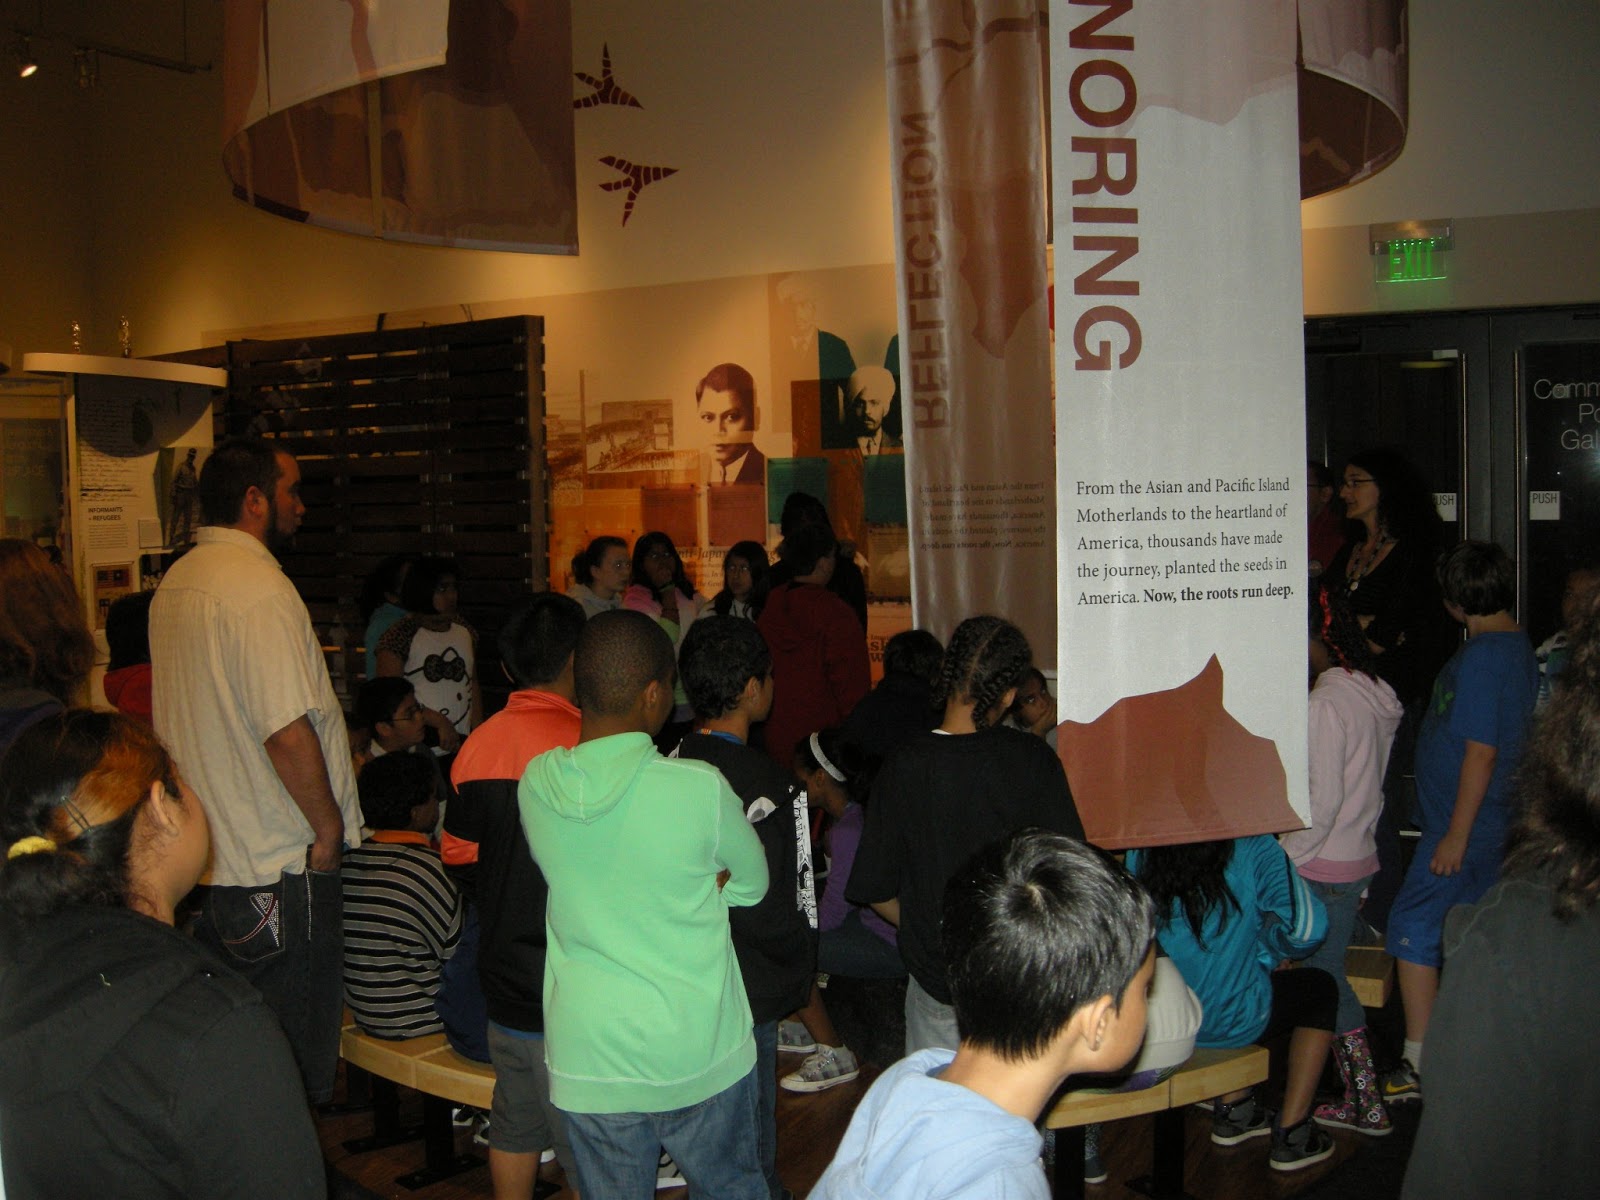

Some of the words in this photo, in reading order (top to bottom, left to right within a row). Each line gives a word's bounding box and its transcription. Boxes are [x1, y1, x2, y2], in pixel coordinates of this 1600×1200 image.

[1068, 0, 1142, 372] NORING
[1388, 241, 1441, 279] EXIT
[1076, 481, 1114, 496] From
[1119, 480, 1142, 495] the
[1145, 480, 1183, 494] Asian
[1187, 478, 1212, 493] and
[1215, 477, 1256, 492] Pacific
[1258, 477, 1290, 491] Island
[1532, 492, 1557, 504] PUSH
[1077, 506, 1167, 523] Motherlands
[1172, 507, 1186, 521] to
[1190, 505, 1212, 520] the
[1215, 503, 1273, 519] heartland
[1275, 503, 1289, 518] of
[1077, 535, 1144, 551] America,
[1147, 532, 1217, 548] thousands
[1221, 531, 1250, 546] have
[1253, 530, 1283, 545] made
[1077, 563, 1100, 578] the
[1102, 562, 1161, 582] journey,
[1164, 558, 1216, 579] planted
[1220, 557, 1240, 573] the
[1243, 557, 1273, 571] seeds
[1275, 557, 1287, 570] in
[1077, 591, 1140, 605] America.
[1143, 589, 1177, 603] Now,
[1180, 587, 1203, 601] the
[1206, 586, 1239, 601] roots
[1241, 586, 1263, 598] run
[1265, 583, 1294, 599] deep.
